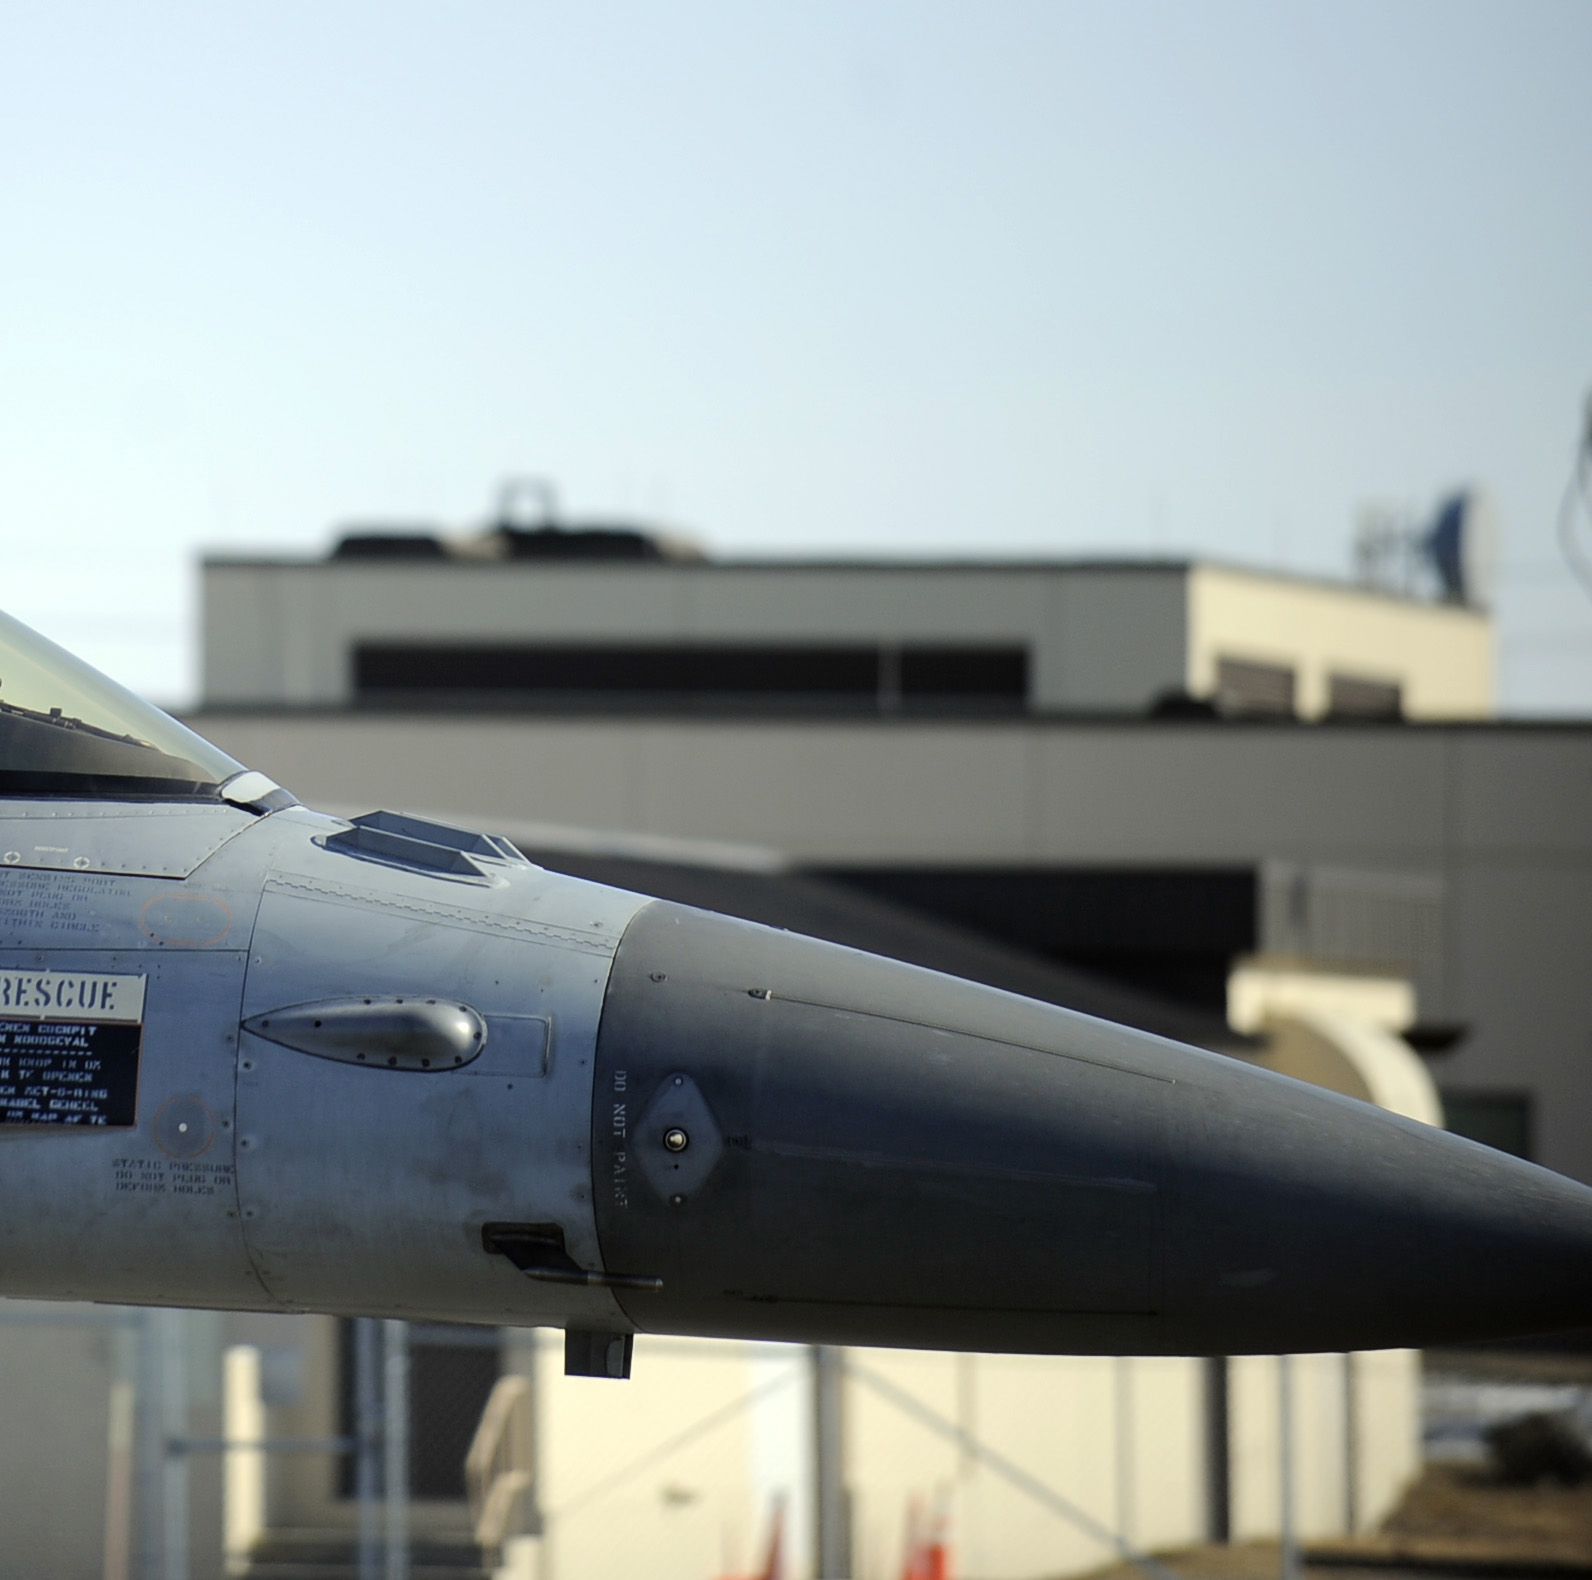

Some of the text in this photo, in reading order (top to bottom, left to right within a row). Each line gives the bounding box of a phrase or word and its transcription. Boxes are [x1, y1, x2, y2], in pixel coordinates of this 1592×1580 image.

[38, 1024, 98, 1036] COCKPIT
[614, 1070, 627, 1092] DO
[613, 1103, 627, 1138] NOT
